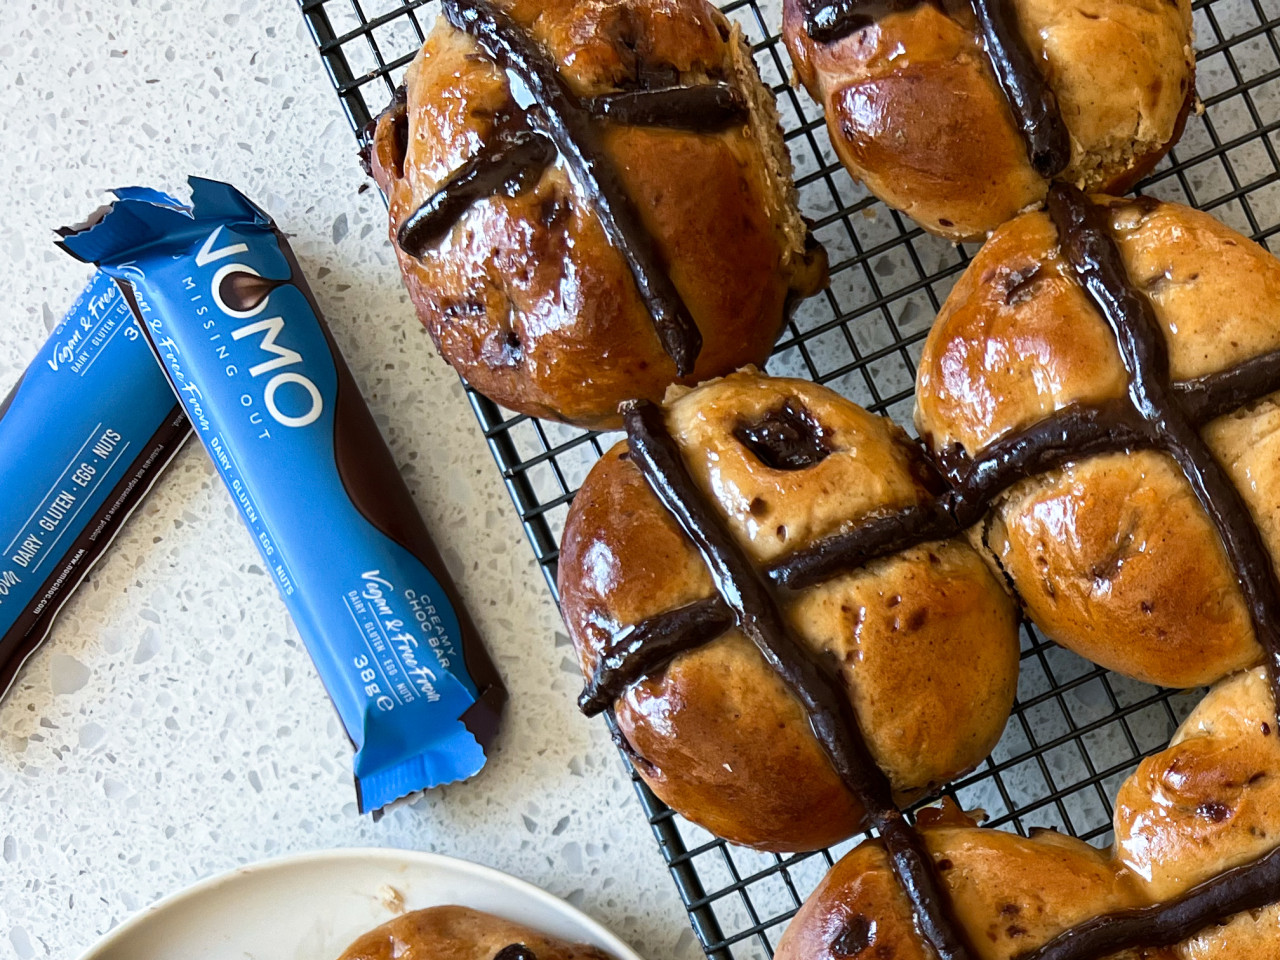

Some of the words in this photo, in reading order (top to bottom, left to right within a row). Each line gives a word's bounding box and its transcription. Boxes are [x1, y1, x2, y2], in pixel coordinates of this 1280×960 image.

[48, 341, 82, 371] Vegan
[80, 316, 92, 331] &
[70, 350, 91, 373] DAIRY
[91, 319, 116, 346] GLUTEN
[182, 276, 239, 378] MISSING
[240, 393, 271, 440] OUT
[149, 319, 163, 335] &
[210, 436, 232, 471] DAIRY
[232, 479, 258, 523] GLUTEN
[259, 532, 274, 556] EGG
[275, 565, 294, 596] NUTS
[12, 530, 43, 568] DAIRY
[39, 489, 76, 532] GLUTEN
[71, 462, 97, 488] EGG
[91, 428, 122, 460] NUTS
[33, 547, 85, 615] www.nomochoc.com
[361, 569, 394, 615] Vegan
[385, 619, 403, 631] &
[348, 590, 366, 614] DAIRY
[364, 621, 385, 653] GLUTEN
[384, 659, 398, 676] EGG
[396, 682, 415, 703] NUTS
[405, 589, 432, 632] CHOC
[429, 637, 450, 668] BAR
[420, 594, 456, 656] CREAMY
